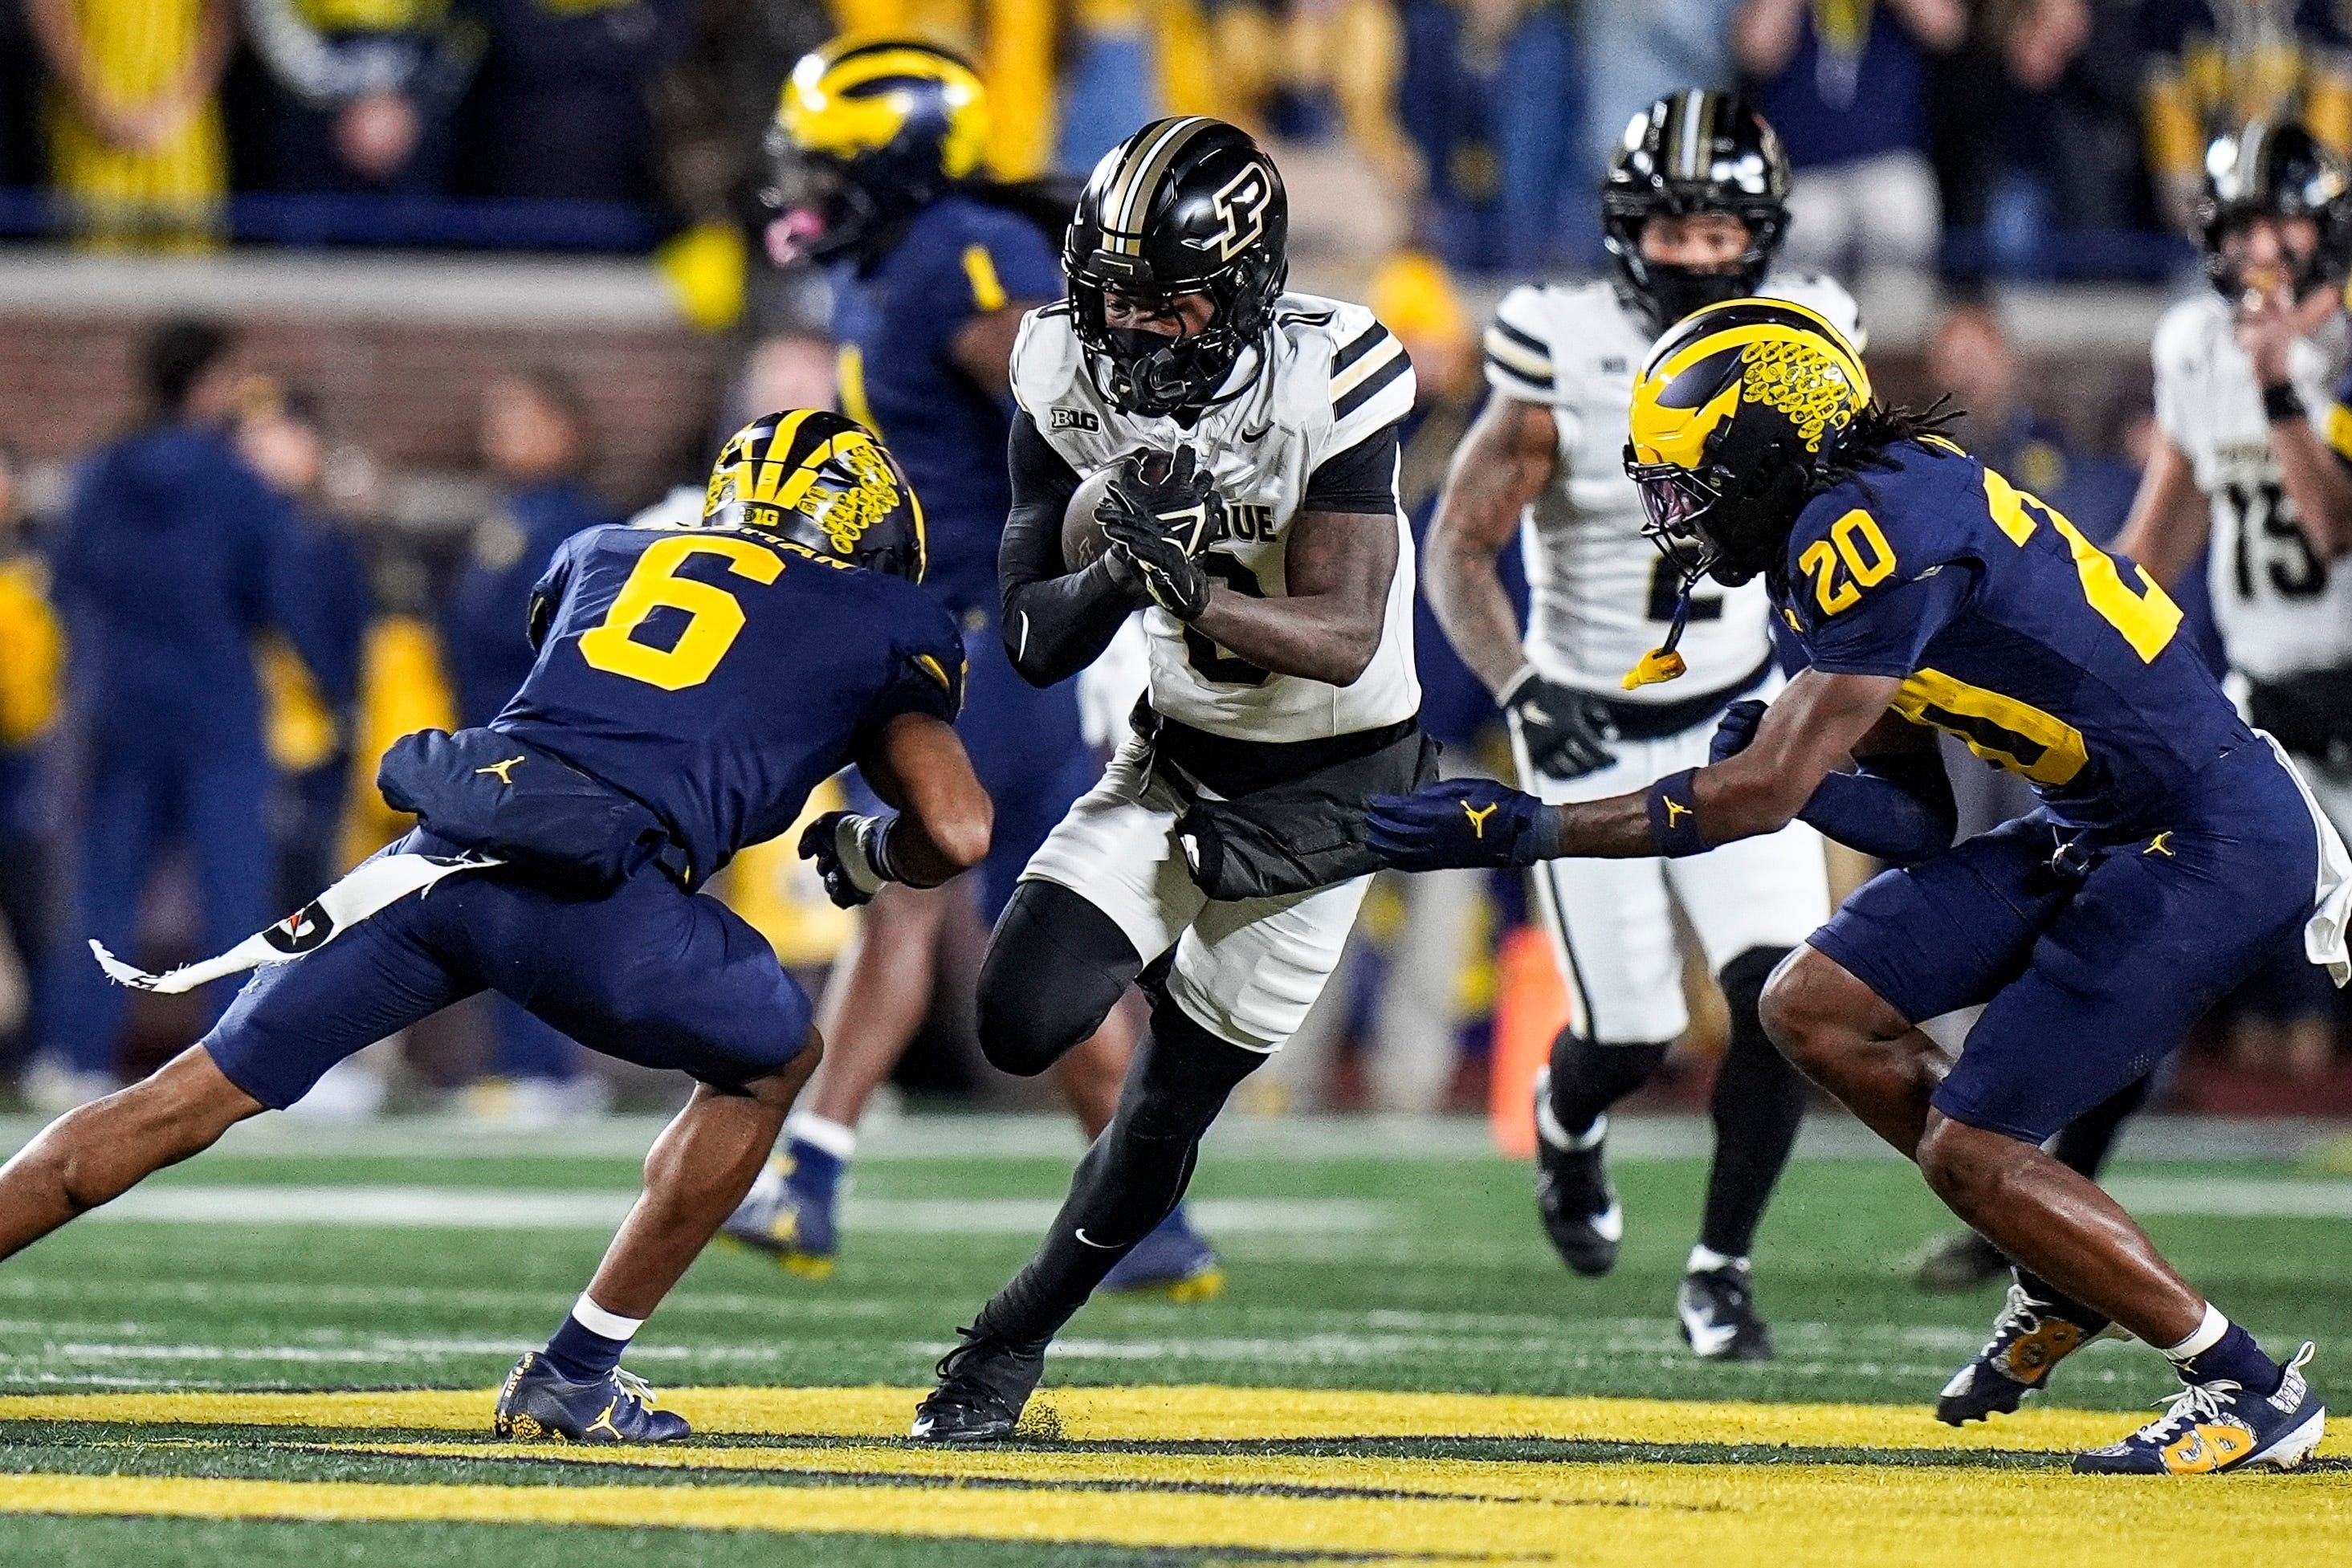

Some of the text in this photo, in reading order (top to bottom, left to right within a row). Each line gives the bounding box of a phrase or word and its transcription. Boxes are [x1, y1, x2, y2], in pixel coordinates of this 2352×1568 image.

[1212, 161, 1271, 262] P
[1799, 509, 1897, 616] 20
[2222, 482, 2328, 601] 15
[578, 535, 785, 690] 6
